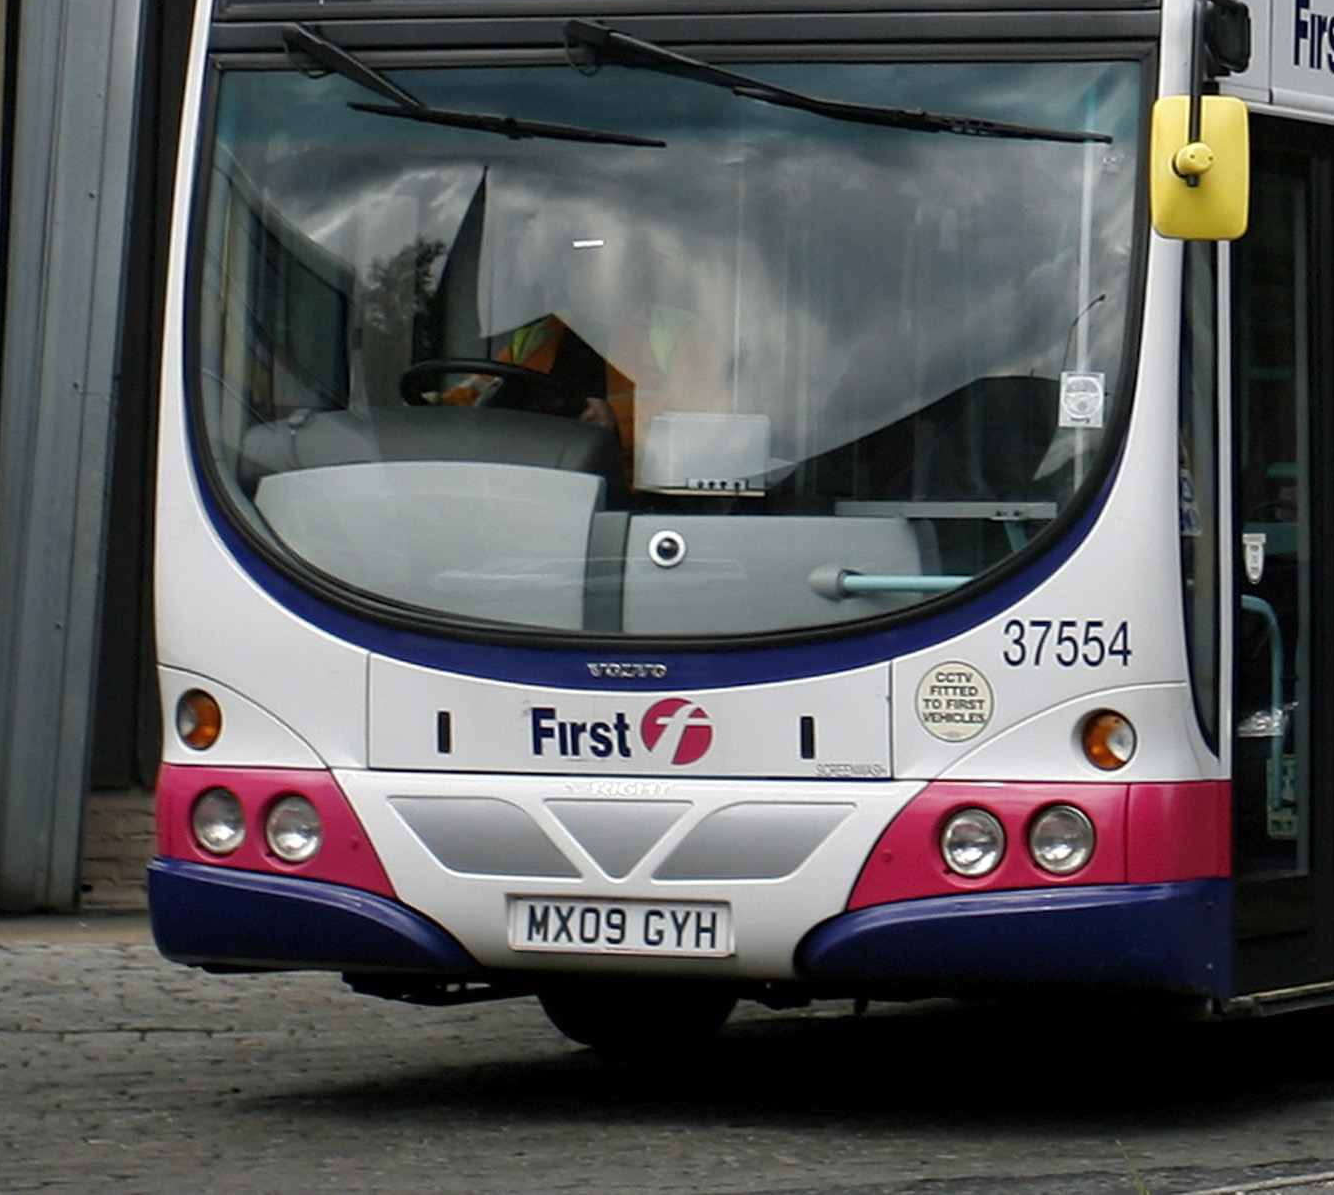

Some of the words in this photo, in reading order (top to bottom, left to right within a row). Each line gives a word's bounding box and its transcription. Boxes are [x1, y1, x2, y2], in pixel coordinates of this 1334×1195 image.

[1002, 619, 1133, 667] 37554
[586, 662, 667, 678] VOLVO
[935, 671, 974, 683] CCTV
[929, 685, 978, 697] FITTED
[922, 698, 942, 709] TO
[946, 699, 986, 710] FIRST
[531, 707, 632, 758] First
[526, 905, 628, 946] MX09
[641, 908, 719, 950] GYH
